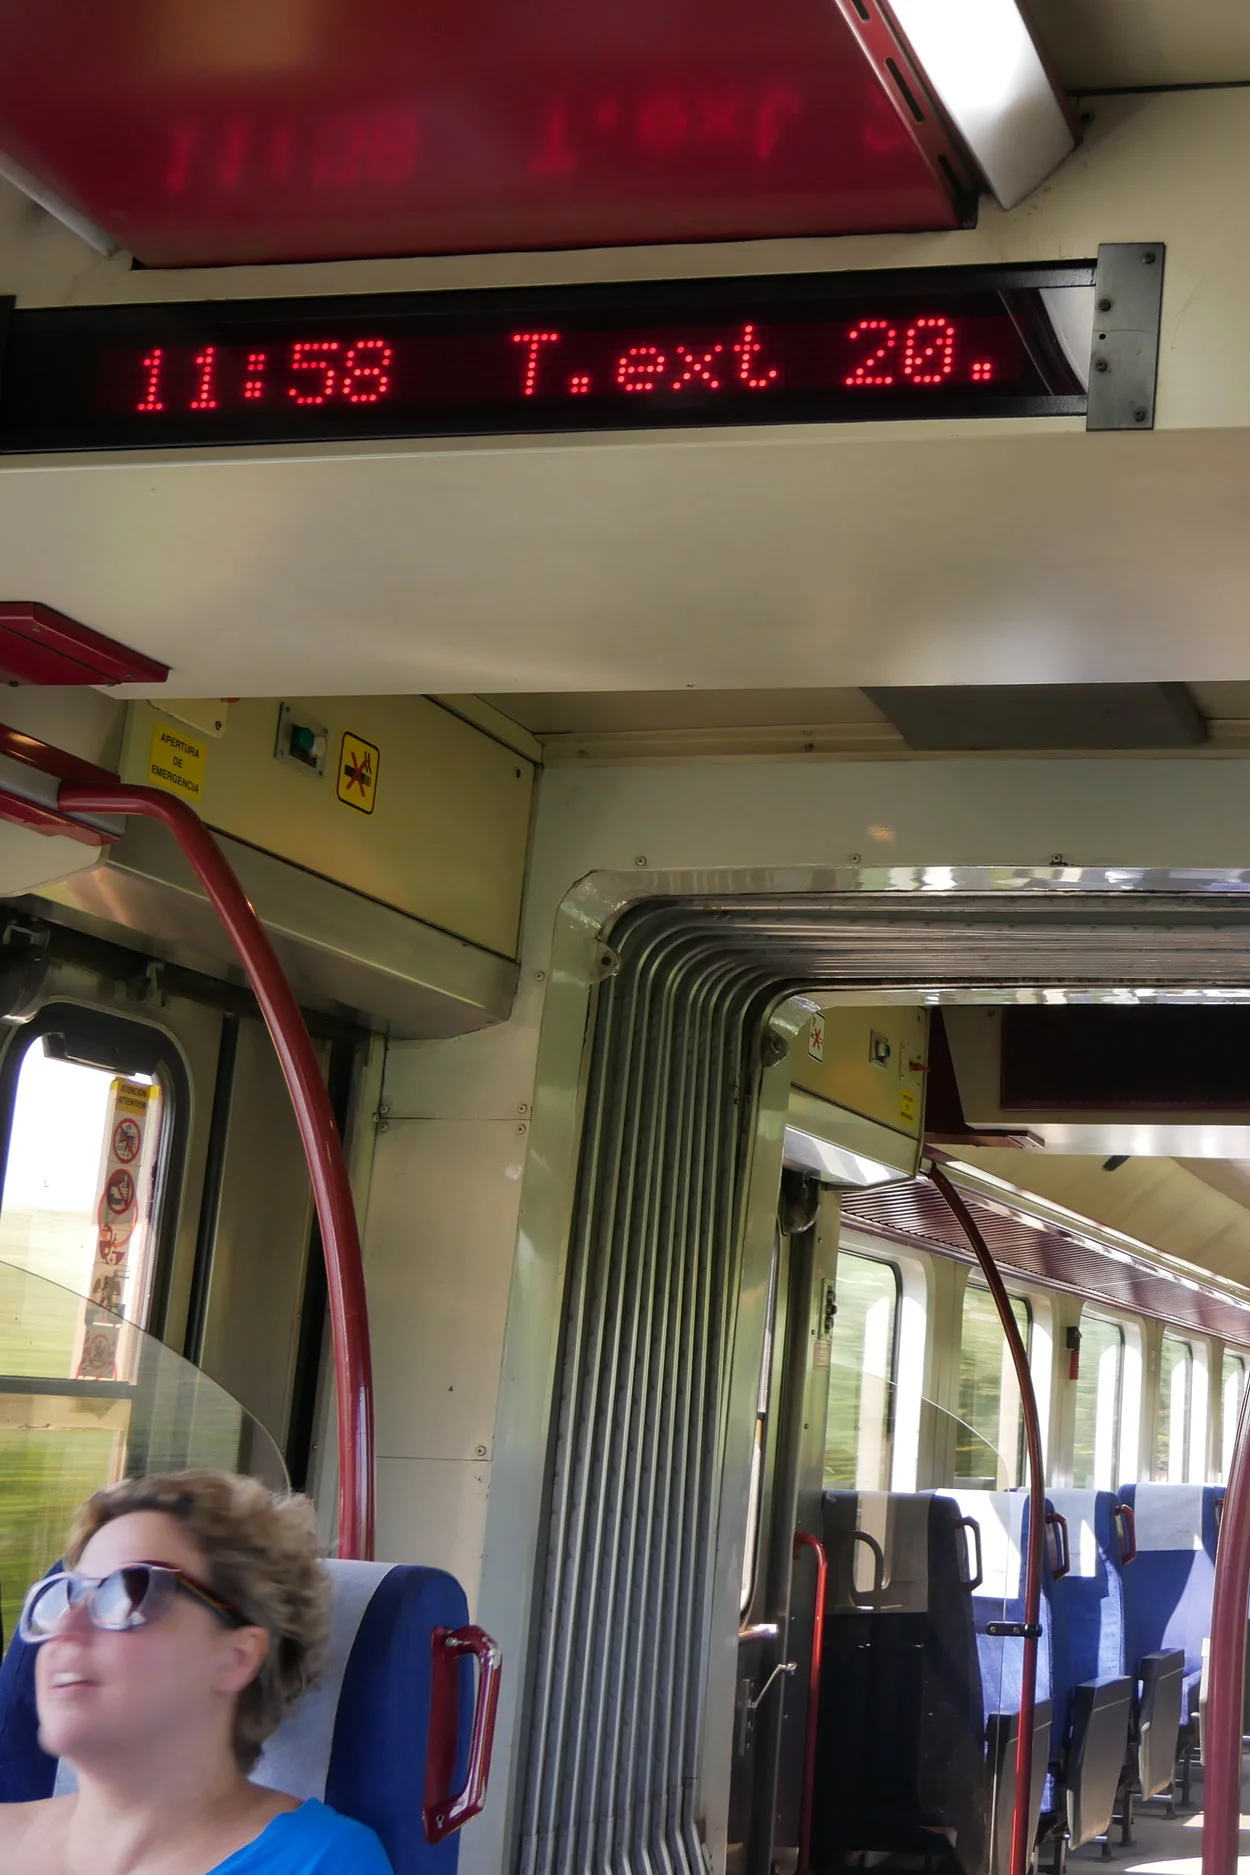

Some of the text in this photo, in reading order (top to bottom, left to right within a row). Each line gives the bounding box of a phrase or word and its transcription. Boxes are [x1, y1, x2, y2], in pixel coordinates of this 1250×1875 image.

[136, 316, 993, 412] 11:58 T.ext 20.
[160, 732, 201, 759] APERTURA
[172, 755, 184, 769] DE
[151, 763, 200, 794] EMERGENCIA
